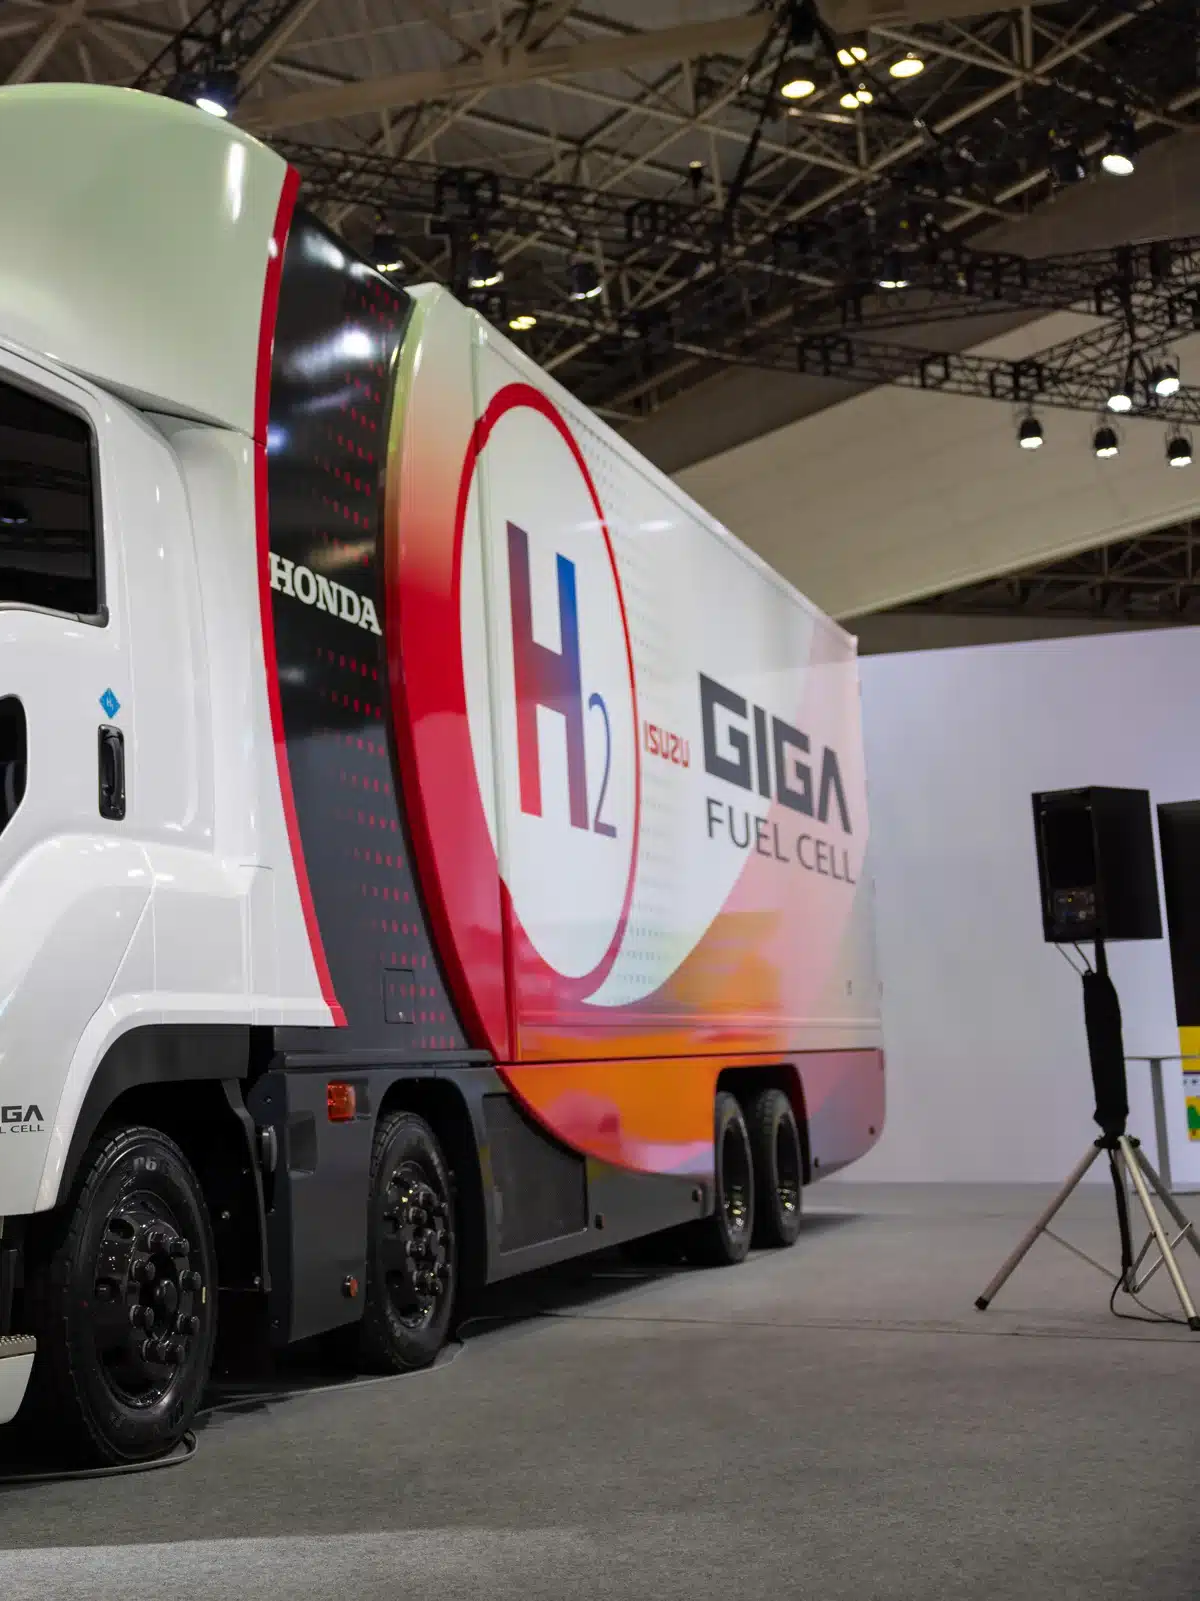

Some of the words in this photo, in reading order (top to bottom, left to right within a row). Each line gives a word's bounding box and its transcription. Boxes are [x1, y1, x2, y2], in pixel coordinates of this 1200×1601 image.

[268, 551, 382, 636] HONDA
[643, 719, 690, 768] ISUZU
[698, 670, 852, 835] GIGA
[706, 796, 790, 873] FUEL
[796, 832, 856, 885] CELL
[10, 1124, 44, 1133] CELL
